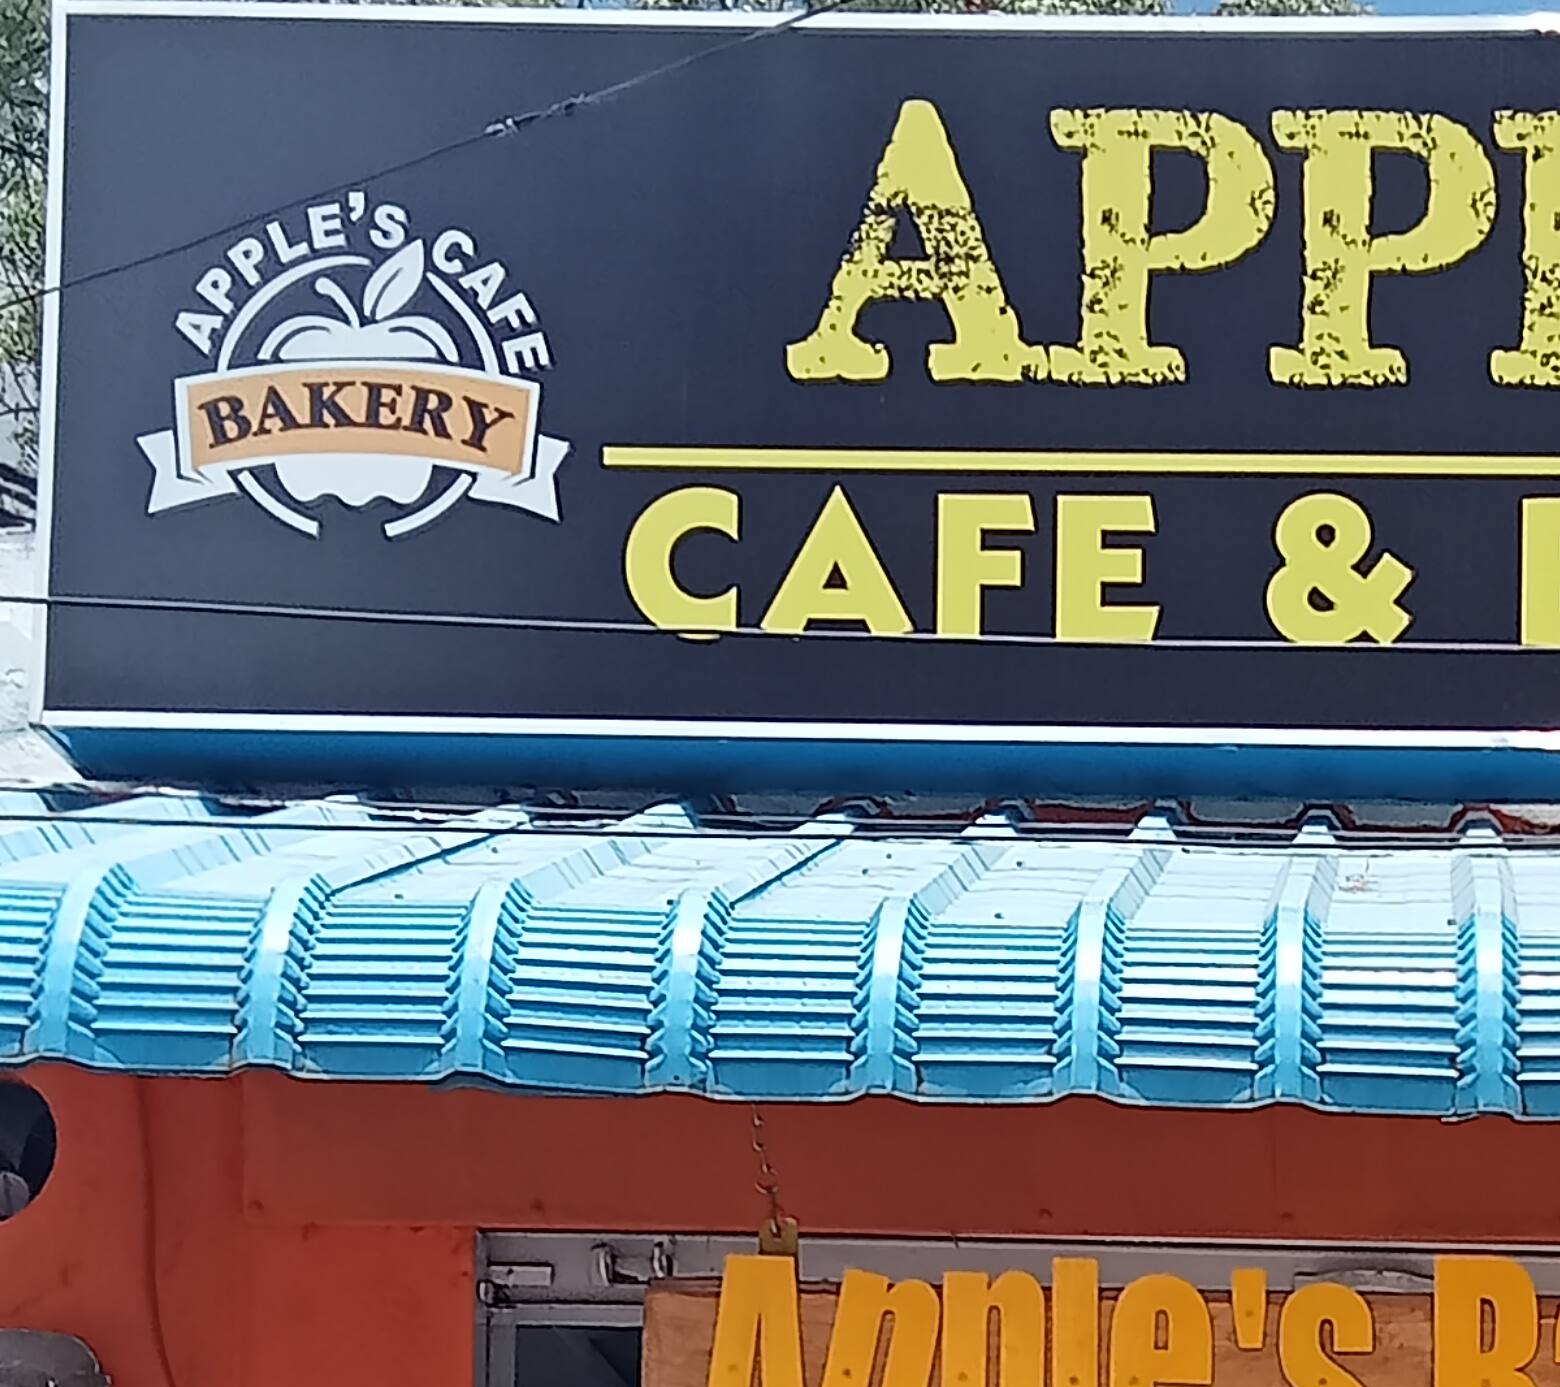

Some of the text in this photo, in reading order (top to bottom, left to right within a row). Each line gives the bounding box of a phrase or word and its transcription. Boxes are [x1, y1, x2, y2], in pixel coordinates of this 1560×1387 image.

[175, 191, 553, 374] APPLE'S CAFE
[197, 380, 515, 453] BAKERY
[622, 486, 1160, 645] CAFE
[1265, 492, 1415, 648] &
